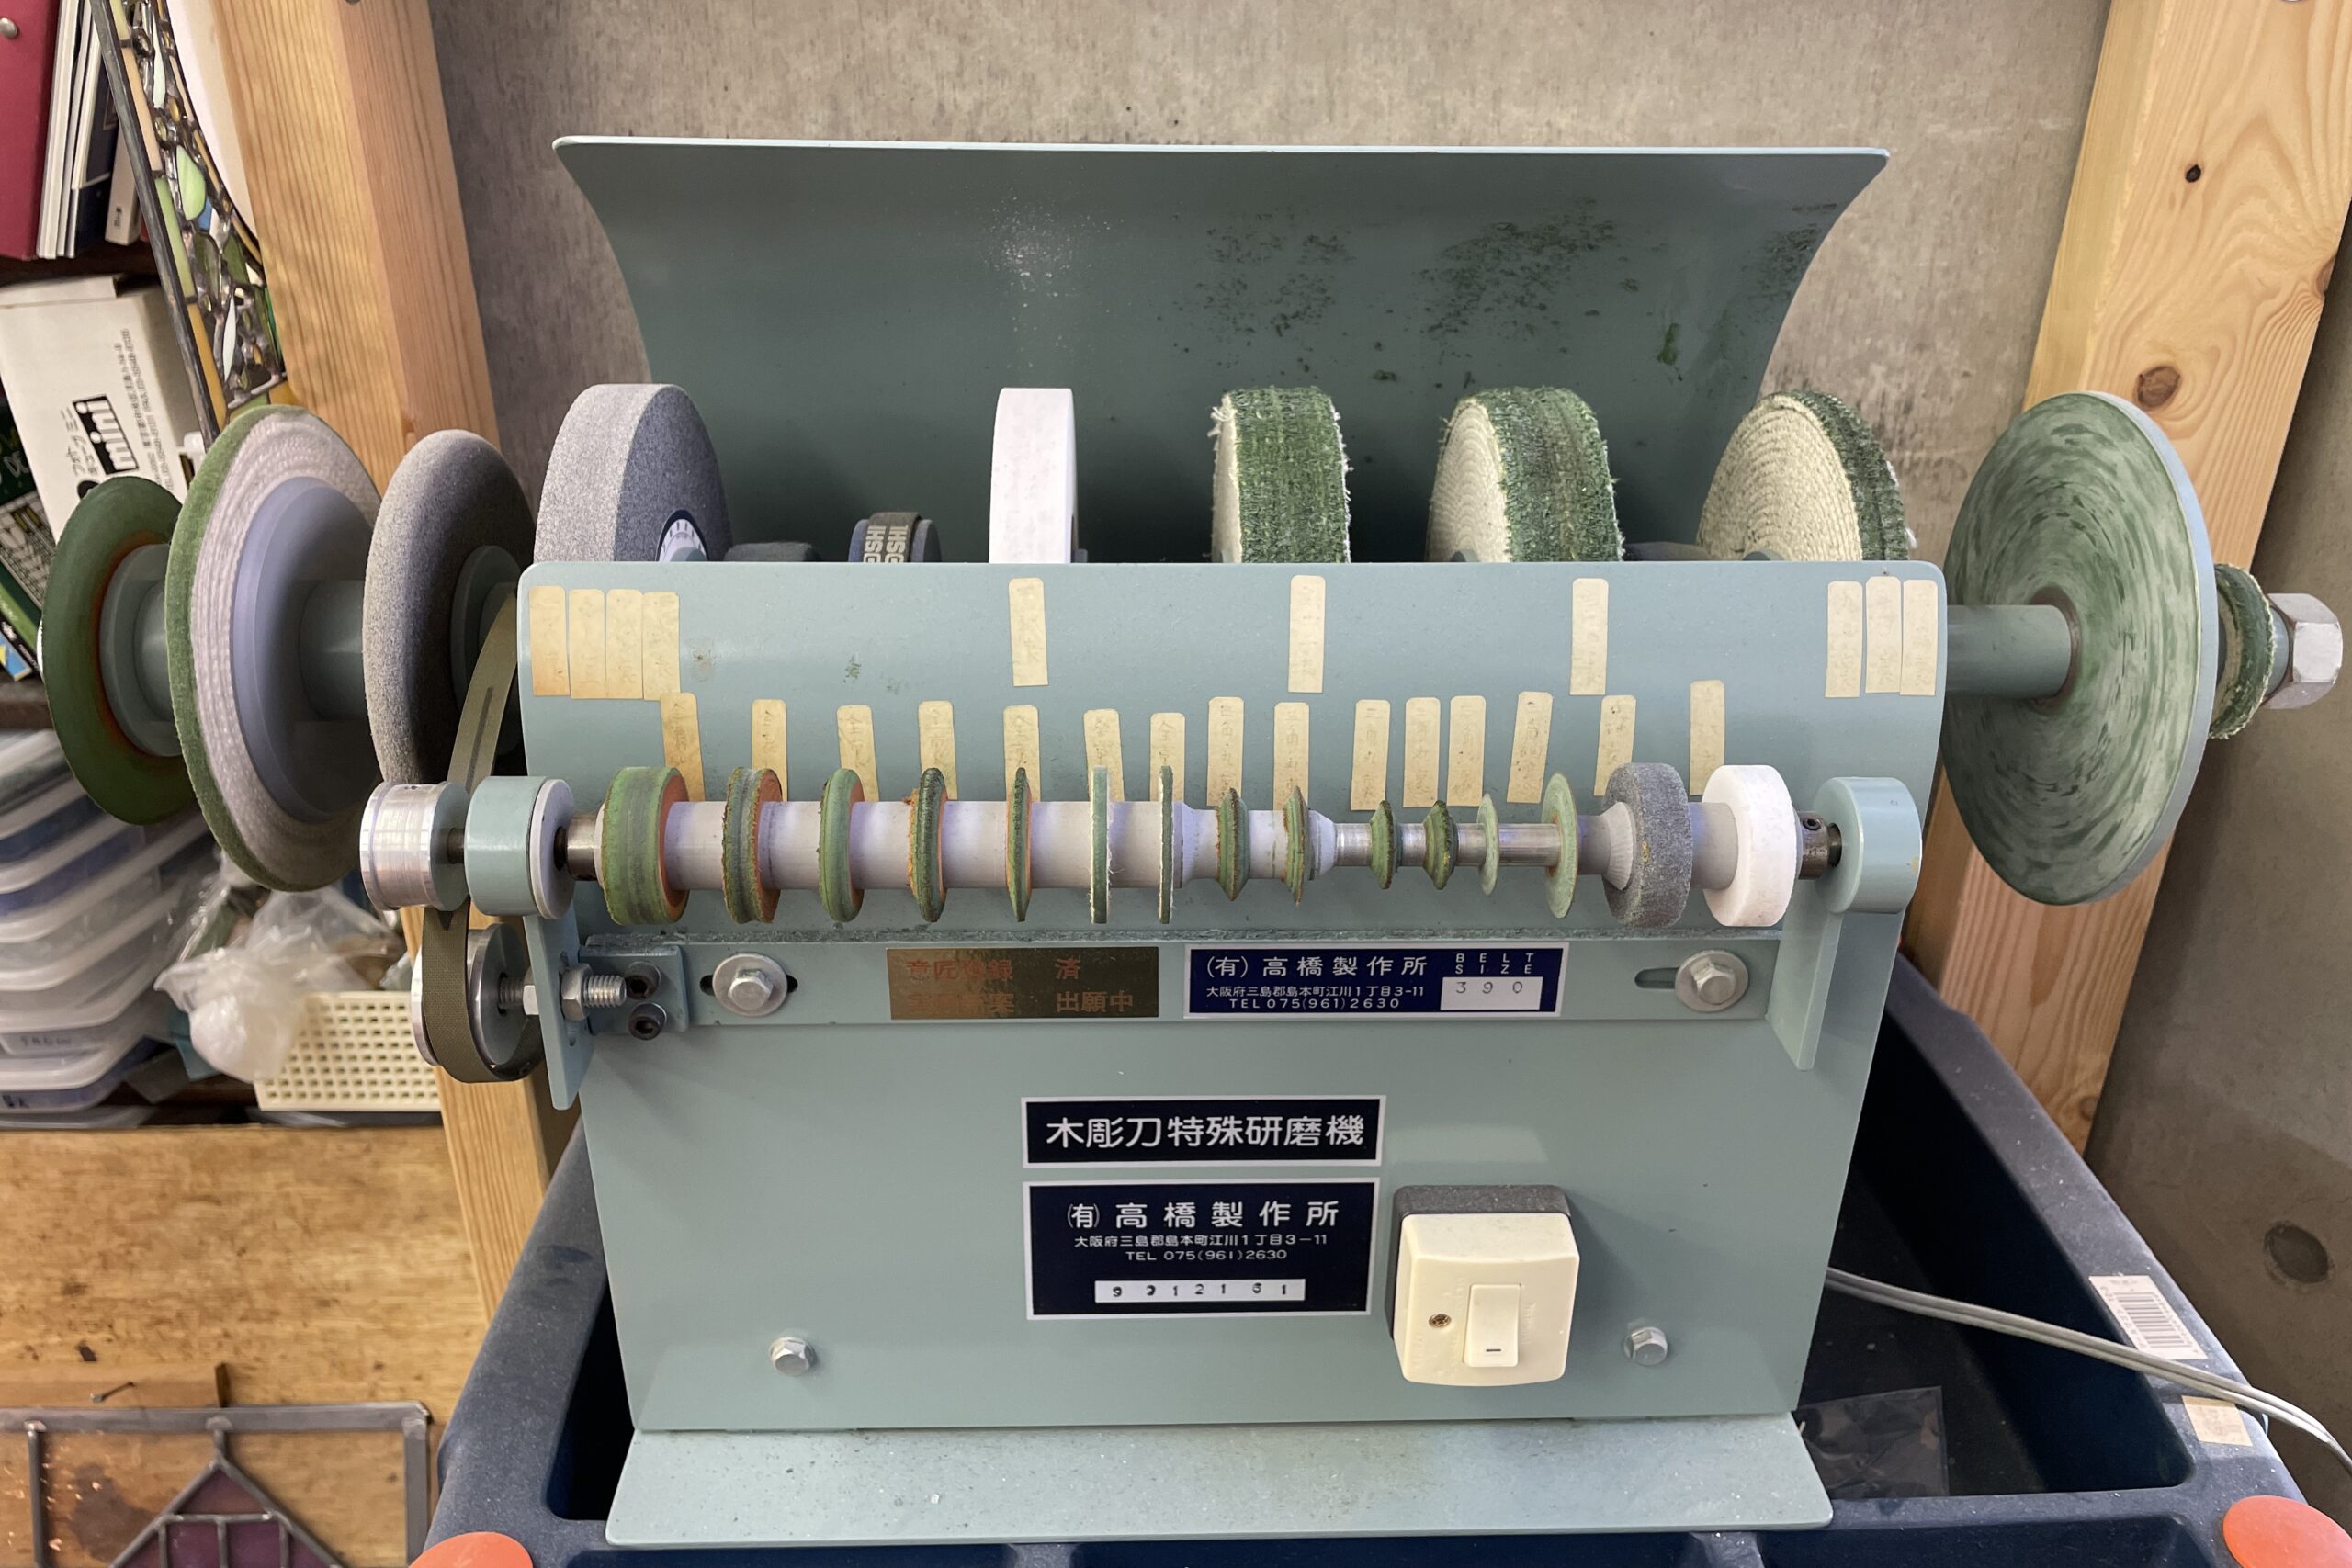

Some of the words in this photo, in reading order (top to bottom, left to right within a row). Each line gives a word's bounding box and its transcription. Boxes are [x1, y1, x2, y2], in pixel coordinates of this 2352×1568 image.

[75, 400, 136, 470] mini
[1055, 957, 1081, 981] 済
[1262, 955, 1428, 976] 高橋製作所
[1456, 953, 1534, 963] BELT
[1454, 964, 1532, 975] SIZE
[1057, 990, 1133, 1014] 出願中
[1229, 998, 1261, 1009] TEL
[1266, 998, 1400, 1010] 075(961)2630
[1046, 1114, 1365, 1149] 木彫刀特殊研磨機
[1115, 1201, 1340, 1229] 高橋製作所
[1125, 1251, 1157, 1261] TEL
[1163, 1249, 1288, 1261] 075(961)2630
